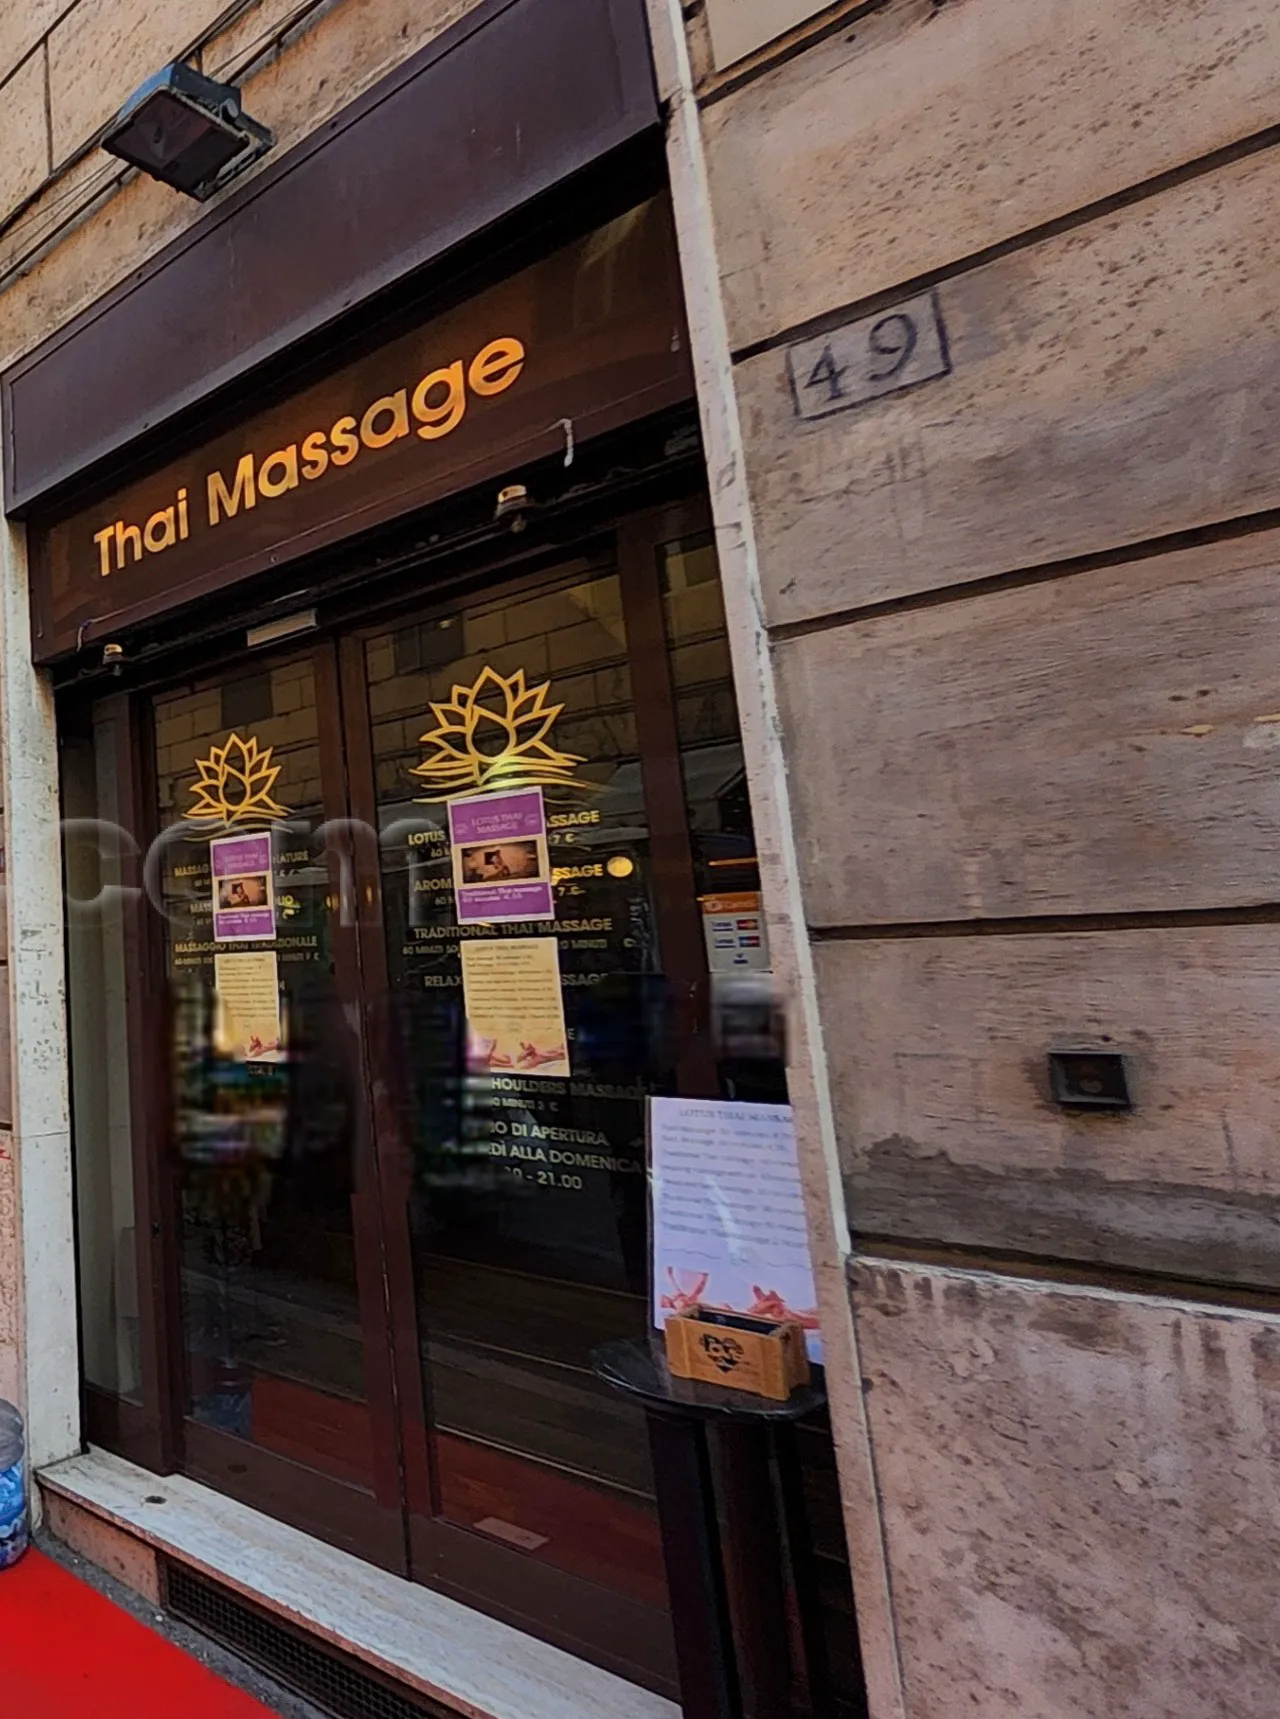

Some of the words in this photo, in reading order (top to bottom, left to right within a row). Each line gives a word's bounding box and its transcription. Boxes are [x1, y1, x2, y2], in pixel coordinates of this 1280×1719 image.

[802, 313, 918, 402] 49
[92, 488, 189, 577] Thai
[206, 336, 526, 527] Massage
[408, 830, 446, 846] LOTUS
[273, 850, 309, 864] NATURE
[414, 925, 498, 940] TRADITIONAL
[501, 923, 535, 935] THAI
[537, 918, 613, 933] MASSAGE
[491, 1077, 567, 1096] HOULDERS
[511, 1122, 528, 1137] DI
[530, 1124, 610, 1147] APERTURA
[509, 1144, 548, 1163] ALLA
[549, 1149, 643, 1175] DOMENICA
[536, 1169, 583, 1190] 21.00
